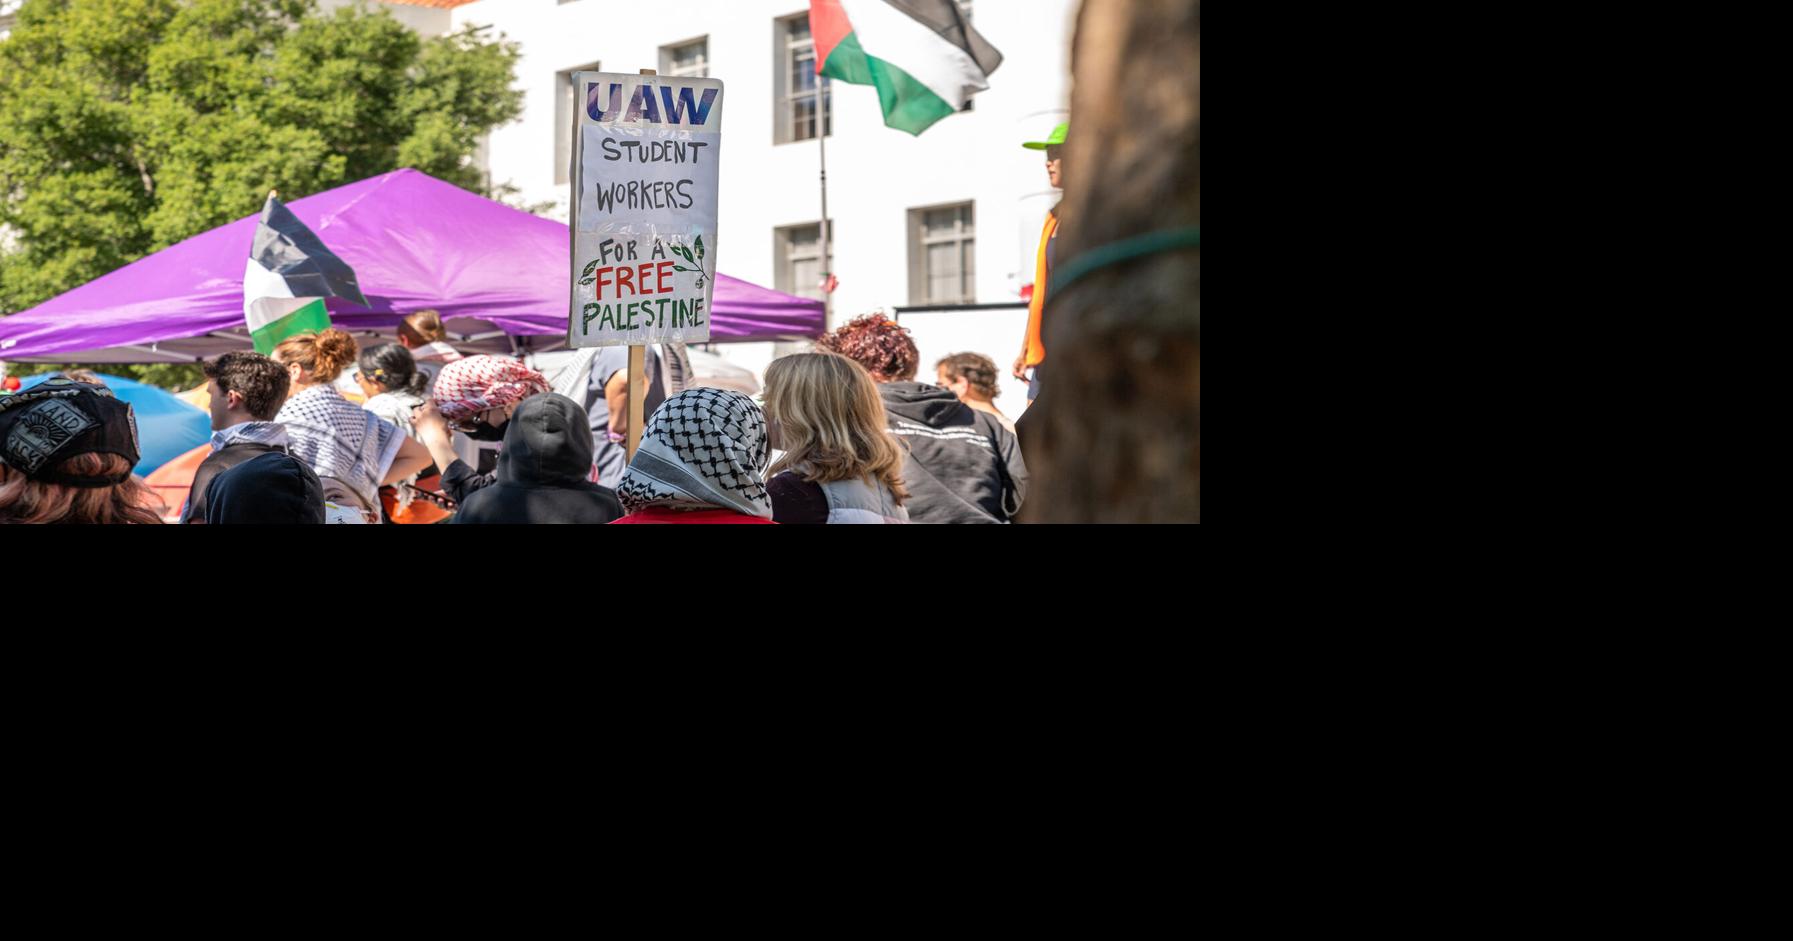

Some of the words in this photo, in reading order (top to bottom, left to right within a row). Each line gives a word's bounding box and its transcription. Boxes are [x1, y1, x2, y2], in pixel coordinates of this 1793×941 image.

[586, 82, 719, 125] UAW
[601, 137, 708, 164] STUDENT
[597, 179, 694, 214] WORKERS
[599, 238, 637, 265] FOR
[651, 239, 666, 260] A
[596, 261, 675, 300] FREE
[582, 298, 705, 335] PALESTINE
[38, 402, 81, 431] LAND
